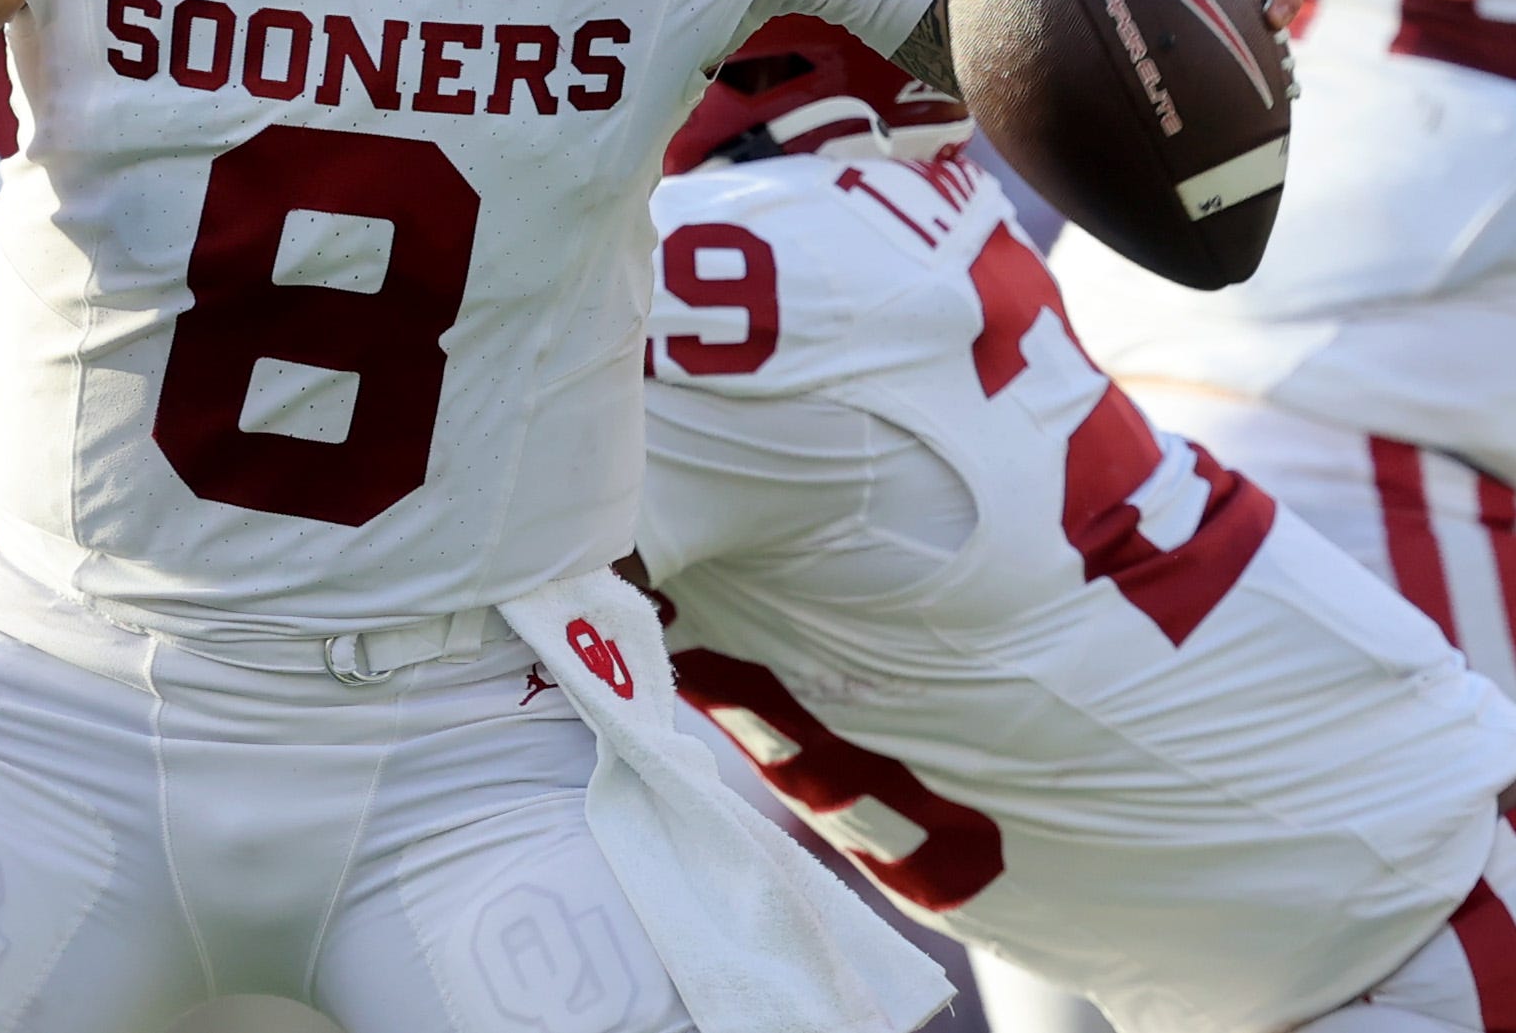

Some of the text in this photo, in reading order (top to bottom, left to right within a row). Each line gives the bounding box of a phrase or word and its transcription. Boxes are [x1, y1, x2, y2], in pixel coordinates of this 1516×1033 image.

[152, 124, 482, 528] 8
[645, 222, 781, 377] 9
[566, 617, 634, 701] OU
